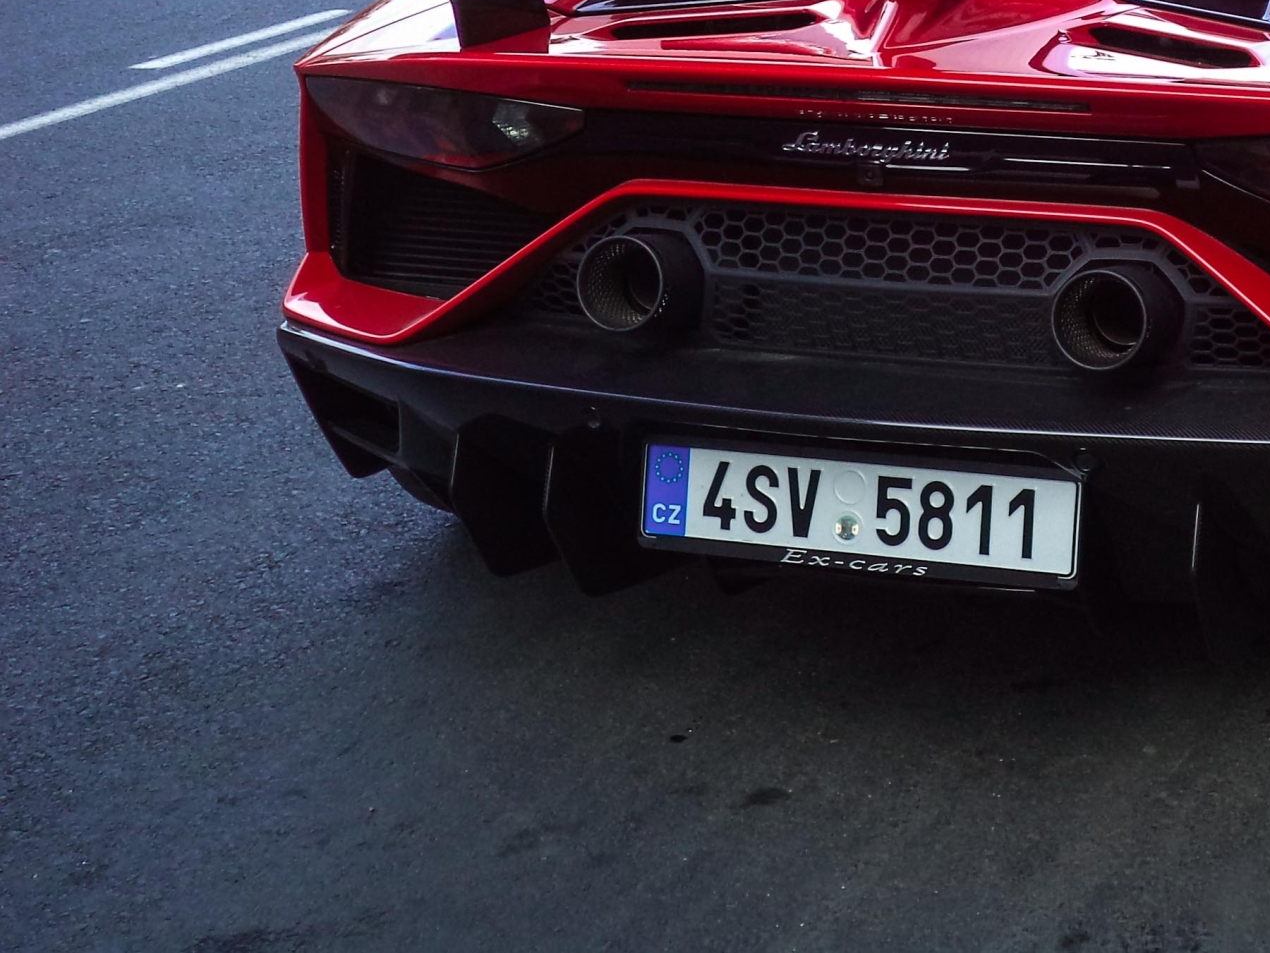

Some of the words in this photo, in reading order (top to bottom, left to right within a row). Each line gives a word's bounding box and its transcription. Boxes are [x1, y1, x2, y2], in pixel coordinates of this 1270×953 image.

[782, 131, 950, 164] Lamborghini
[651, 502, 681, 526] CZ
[702, 460, 822, 538] 4SV
[875, 474, 1036, 560] 5811
[780, 548, 929, 577] Ex-cars
